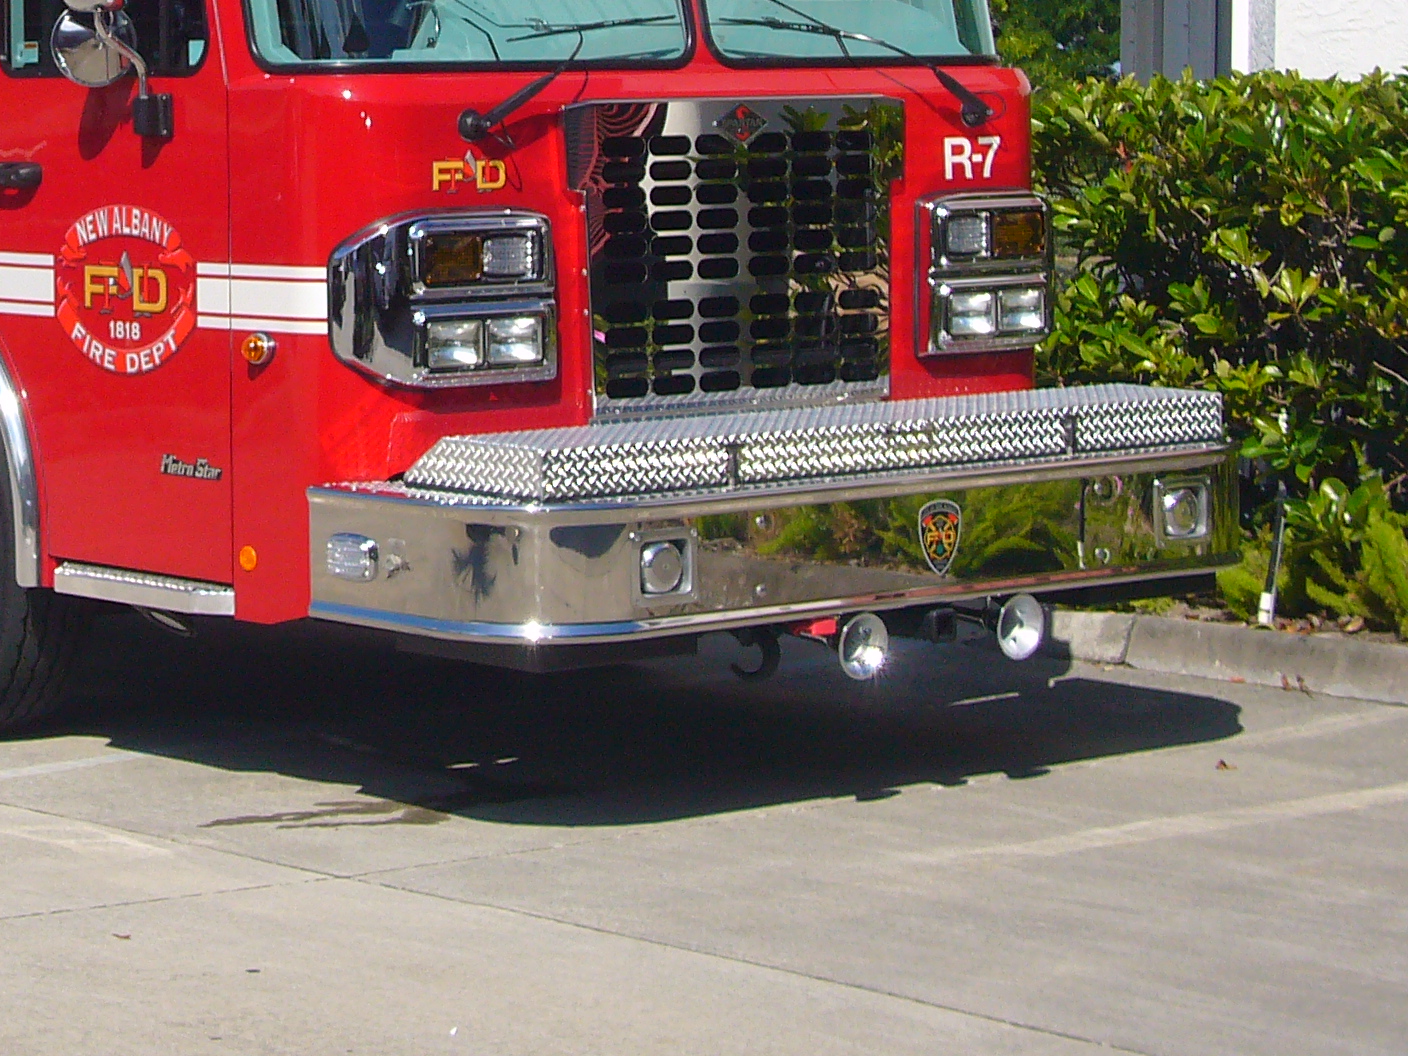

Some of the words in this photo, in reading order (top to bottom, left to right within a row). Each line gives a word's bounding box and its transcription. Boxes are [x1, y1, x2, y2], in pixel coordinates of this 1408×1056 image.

[943, 135, 1001, 180] R-7
[75, 209, 108, 246] NEW
[112, 206, 173, 248] ALBANY
[71, 321, 117, 372] FIRE
[125, 328, 178, 374] DEPT
[109, 319, 141, 341] 1818
[160, 453, 194, 477] Metro
[195, 457, 222, 481] Star
